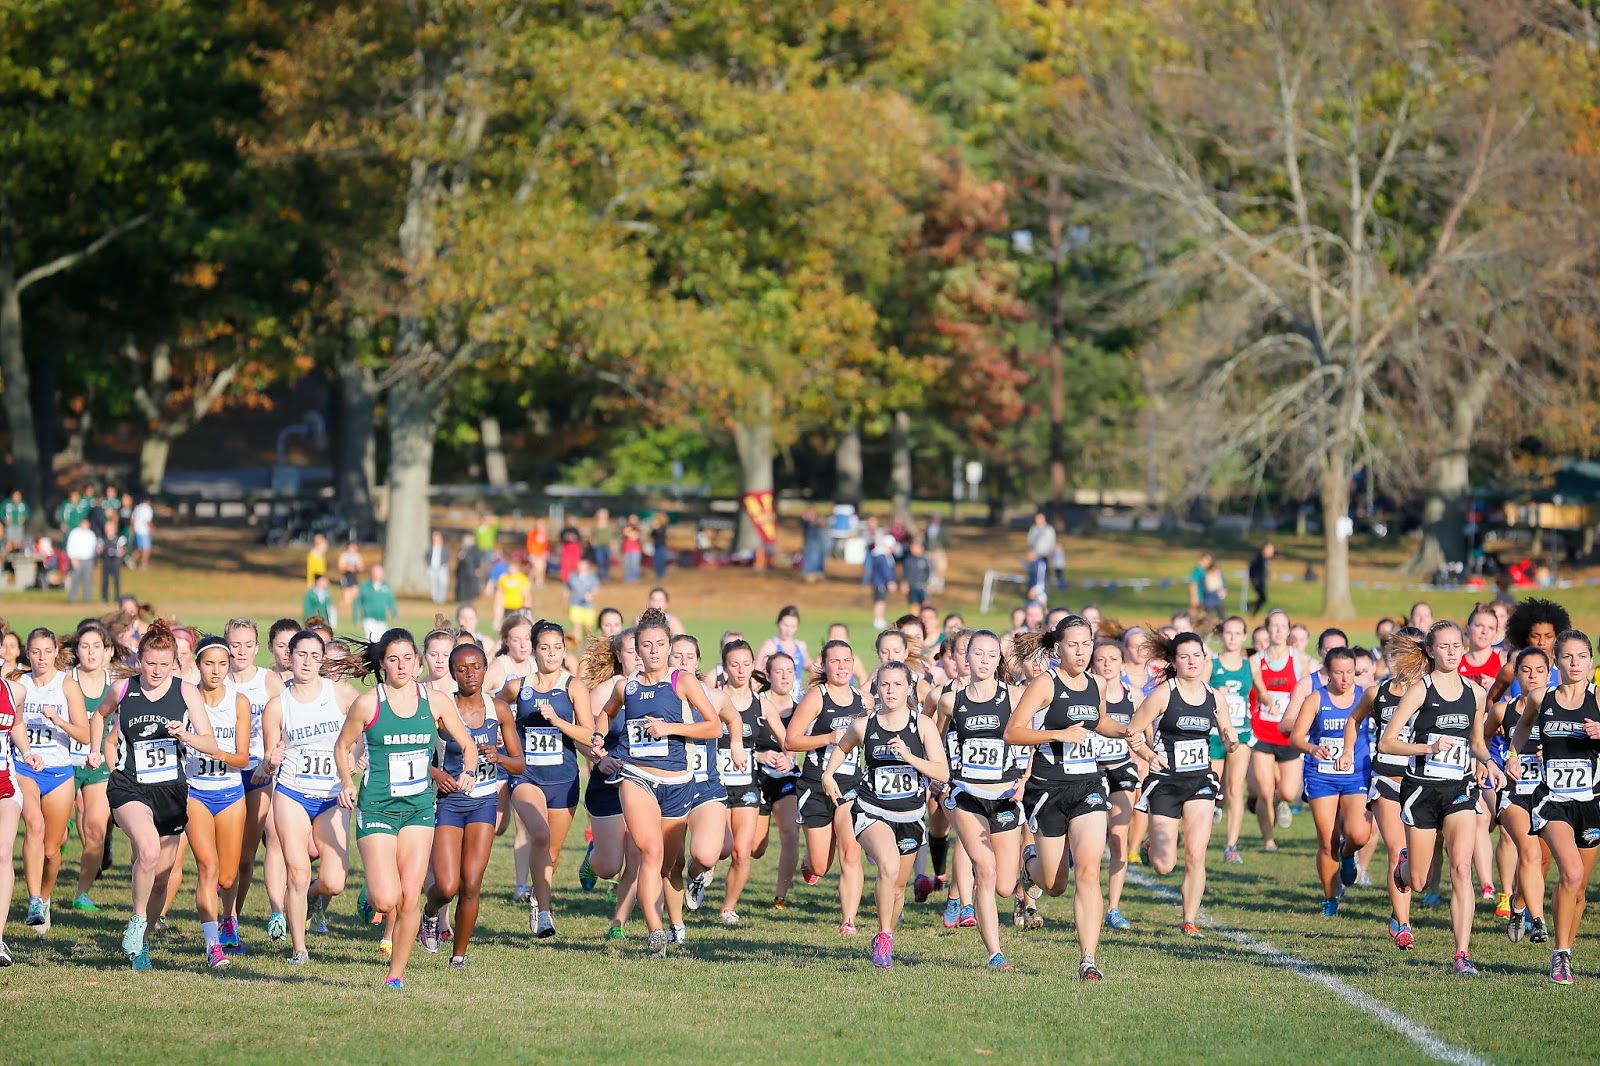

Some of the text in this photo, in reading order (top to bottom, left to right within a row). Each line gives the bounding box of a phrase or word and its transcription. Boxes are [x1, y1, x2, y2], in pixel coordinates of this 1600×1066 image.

[640, 691, 655, 700] JWU
[831, 717, 851, 728] UN
[966, 715, 1000, 726] UNE
[1324, 718, 1362, 731] SUFF
[1437, 715, 1468, 725] UNE
[27, 728, 52, 745] 313
[286, 720, 340, 742] WHEATON
[383, 734, 431, 745] BABSON
[474, 733, 488, 744] JWU
[633, 726, 661, 743] 34
[530, 735, 557, 751] 344
[1099, 739, 1122, 755] 255
[146, 748, 166, 768] 59
[969, 746, 998, 765] 258
[1181, 747, 1204, 765] 254
[198, 758, 227, 776] 319
[302, 756, 331, 775] 316
[408, 761, 414, 780] 1
[475, 763, 496, 783] 52
[881, 774, 912, 793] 248
[1553, 768, 1587, 788] 272
